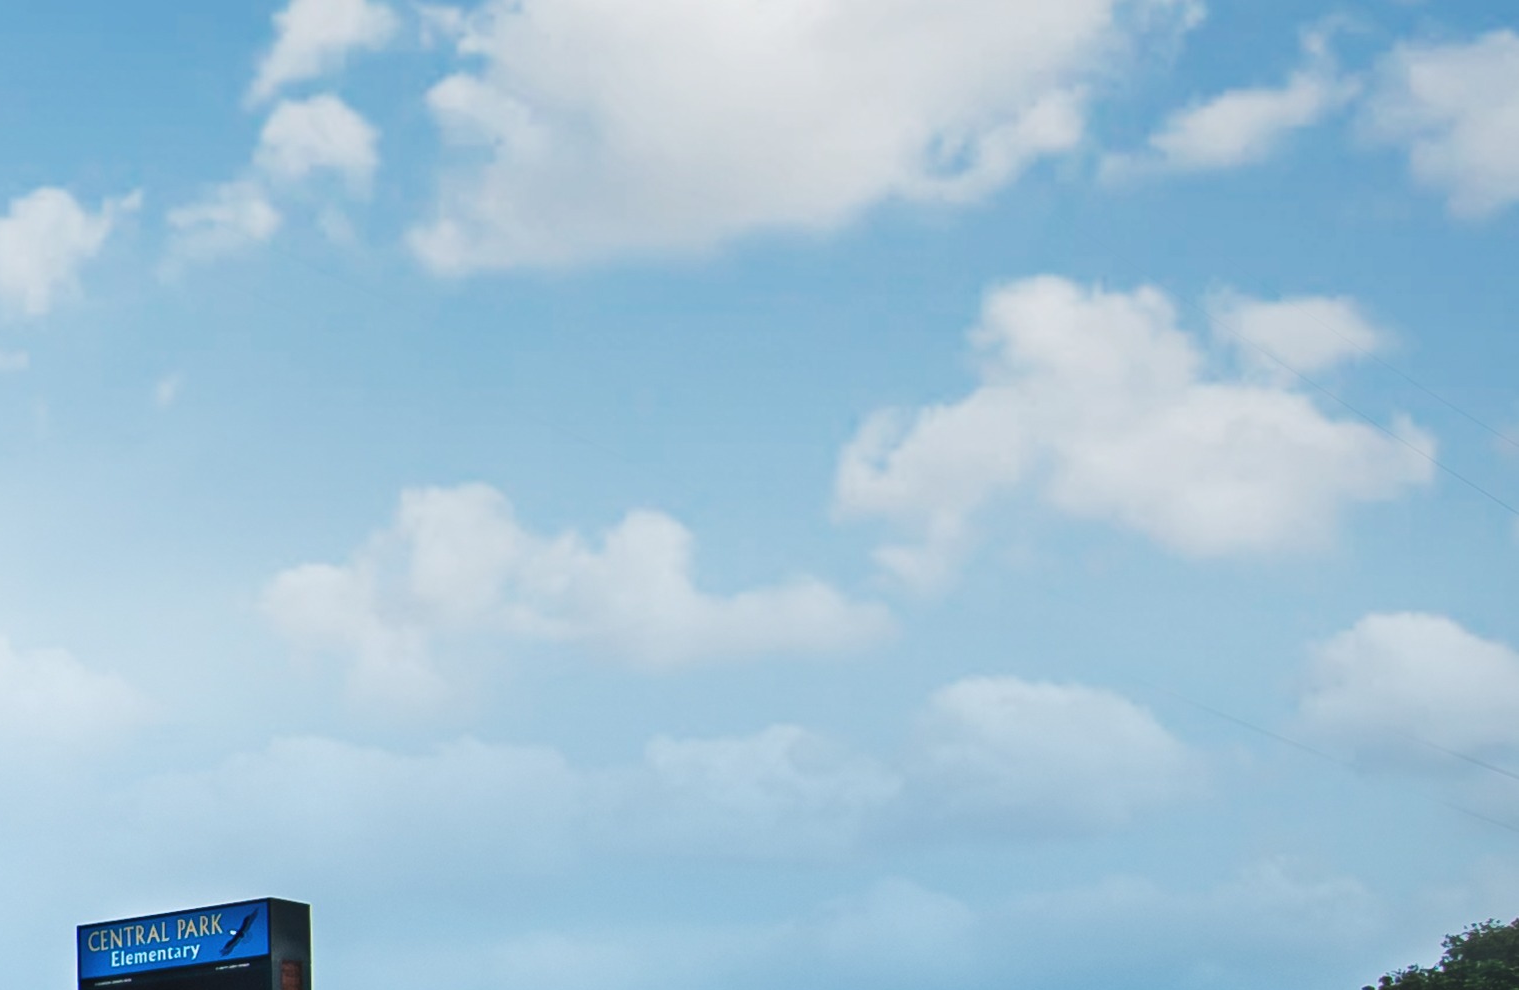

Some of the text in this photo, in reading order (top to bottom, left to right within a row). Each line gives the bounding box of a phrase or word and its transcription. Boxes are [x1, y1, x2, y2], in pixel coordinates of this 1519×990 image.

[88, 913, 223, 952] CENTRAL PARK
[111, 944, 200, 967] Elementary
